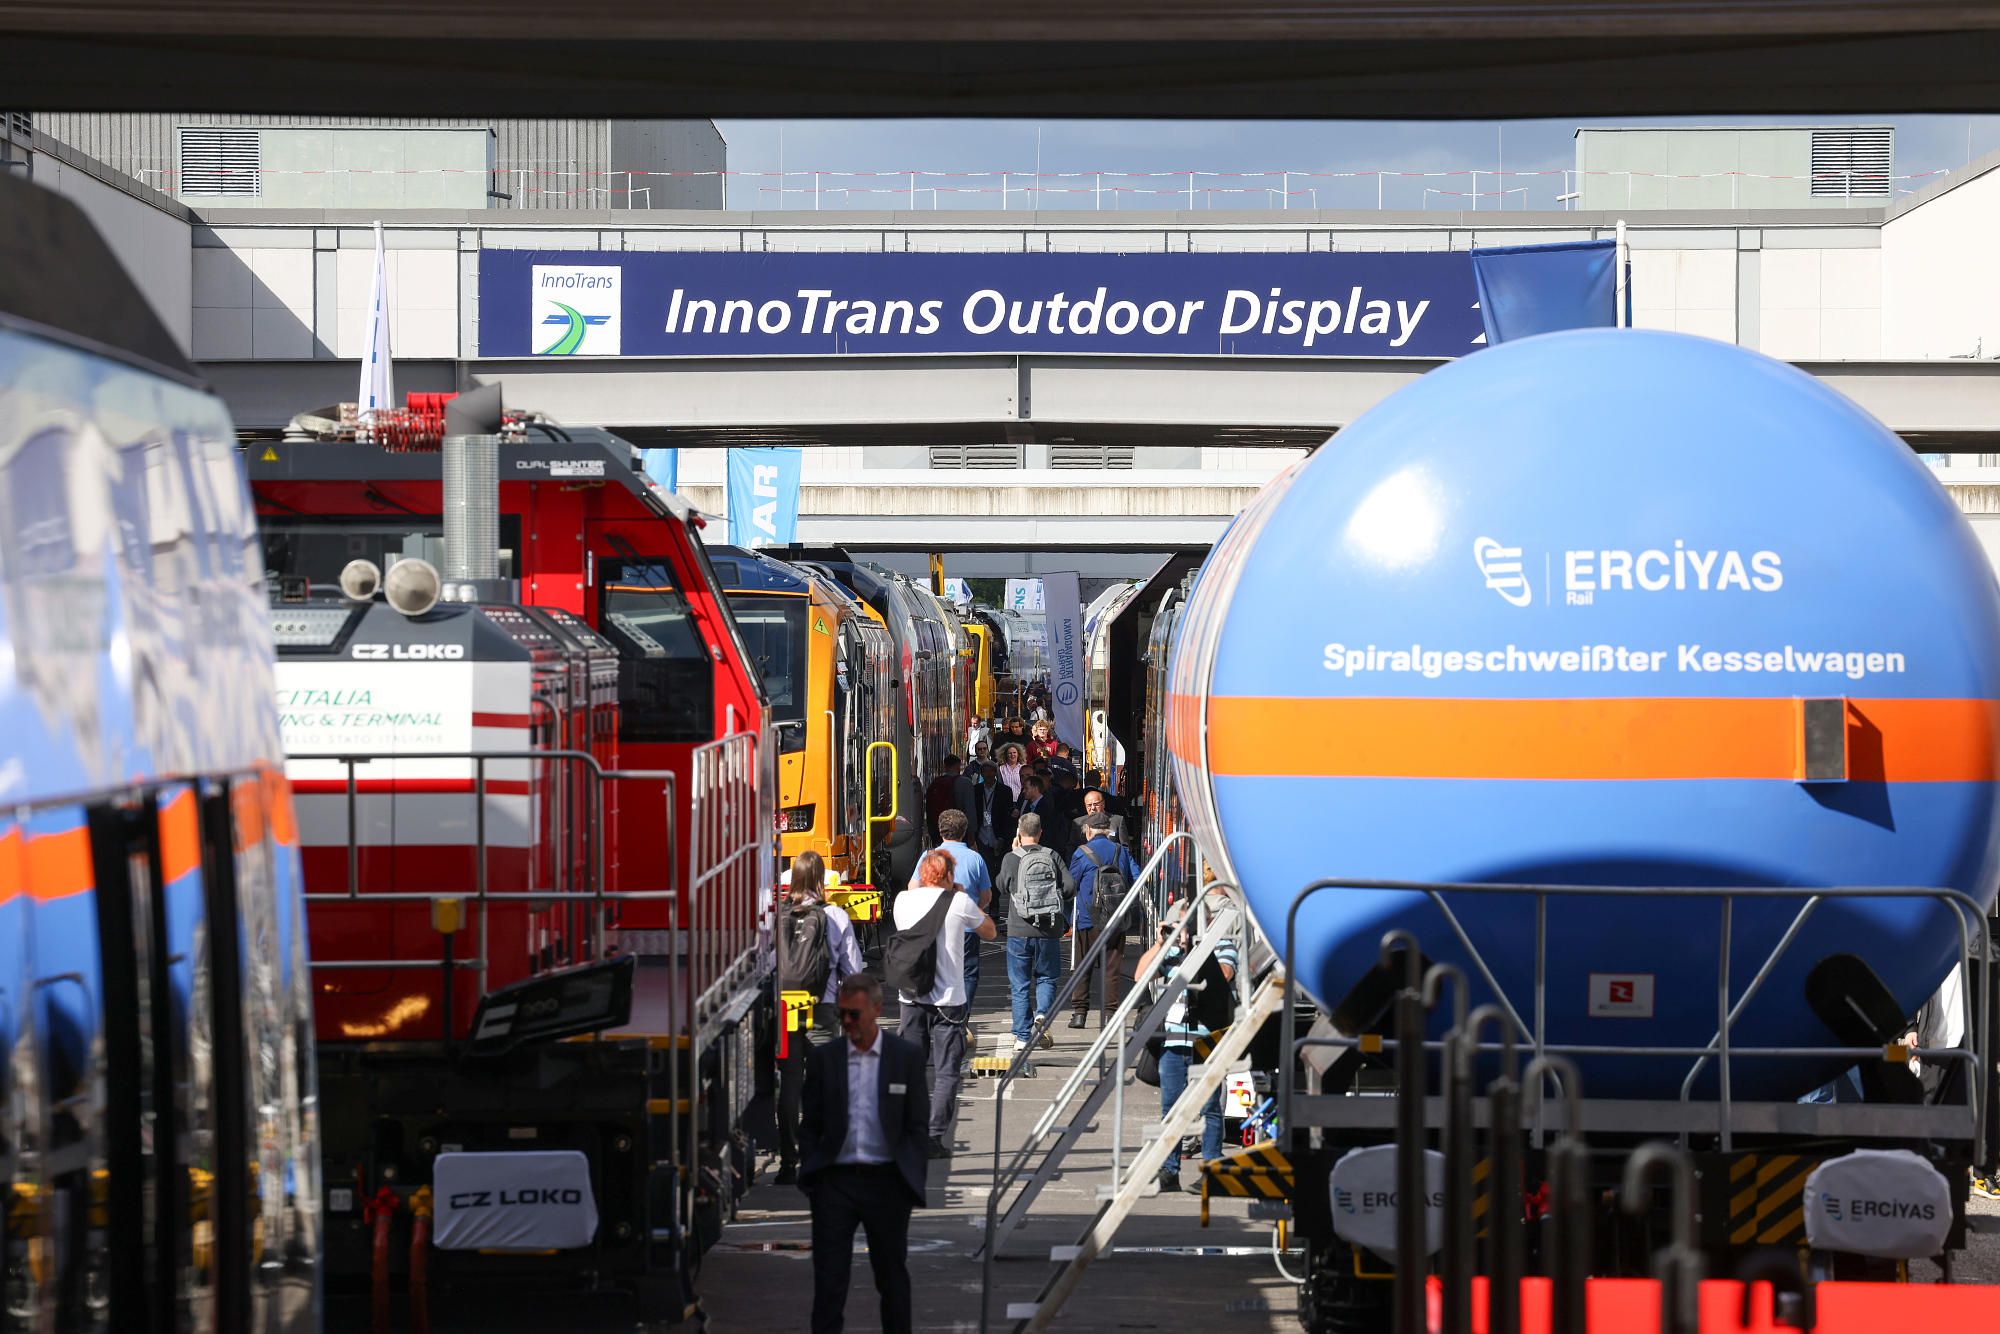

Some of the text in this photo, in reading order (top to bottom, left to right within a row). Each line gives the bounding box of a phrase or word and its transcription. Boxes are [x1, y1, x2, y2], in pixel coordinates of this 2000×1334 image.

[541, 272, 613, 290] InnoTrans
[665, 287, 1430, 347] InnoTrans Outdoor Display
[1565, 591, 1593, 605] Rail
[352, 644, 465, 660] CZ LOKO
[1323, 644, 1906, 679] Spiralgeschweißter Kesselwagen
[276, 690, 371, 706] CITALIA
[319, 714, 335, 727] &
[341, 713, 443, 727] TERMINAL
[450, 1189, 582, 1209] CZ LOKO
